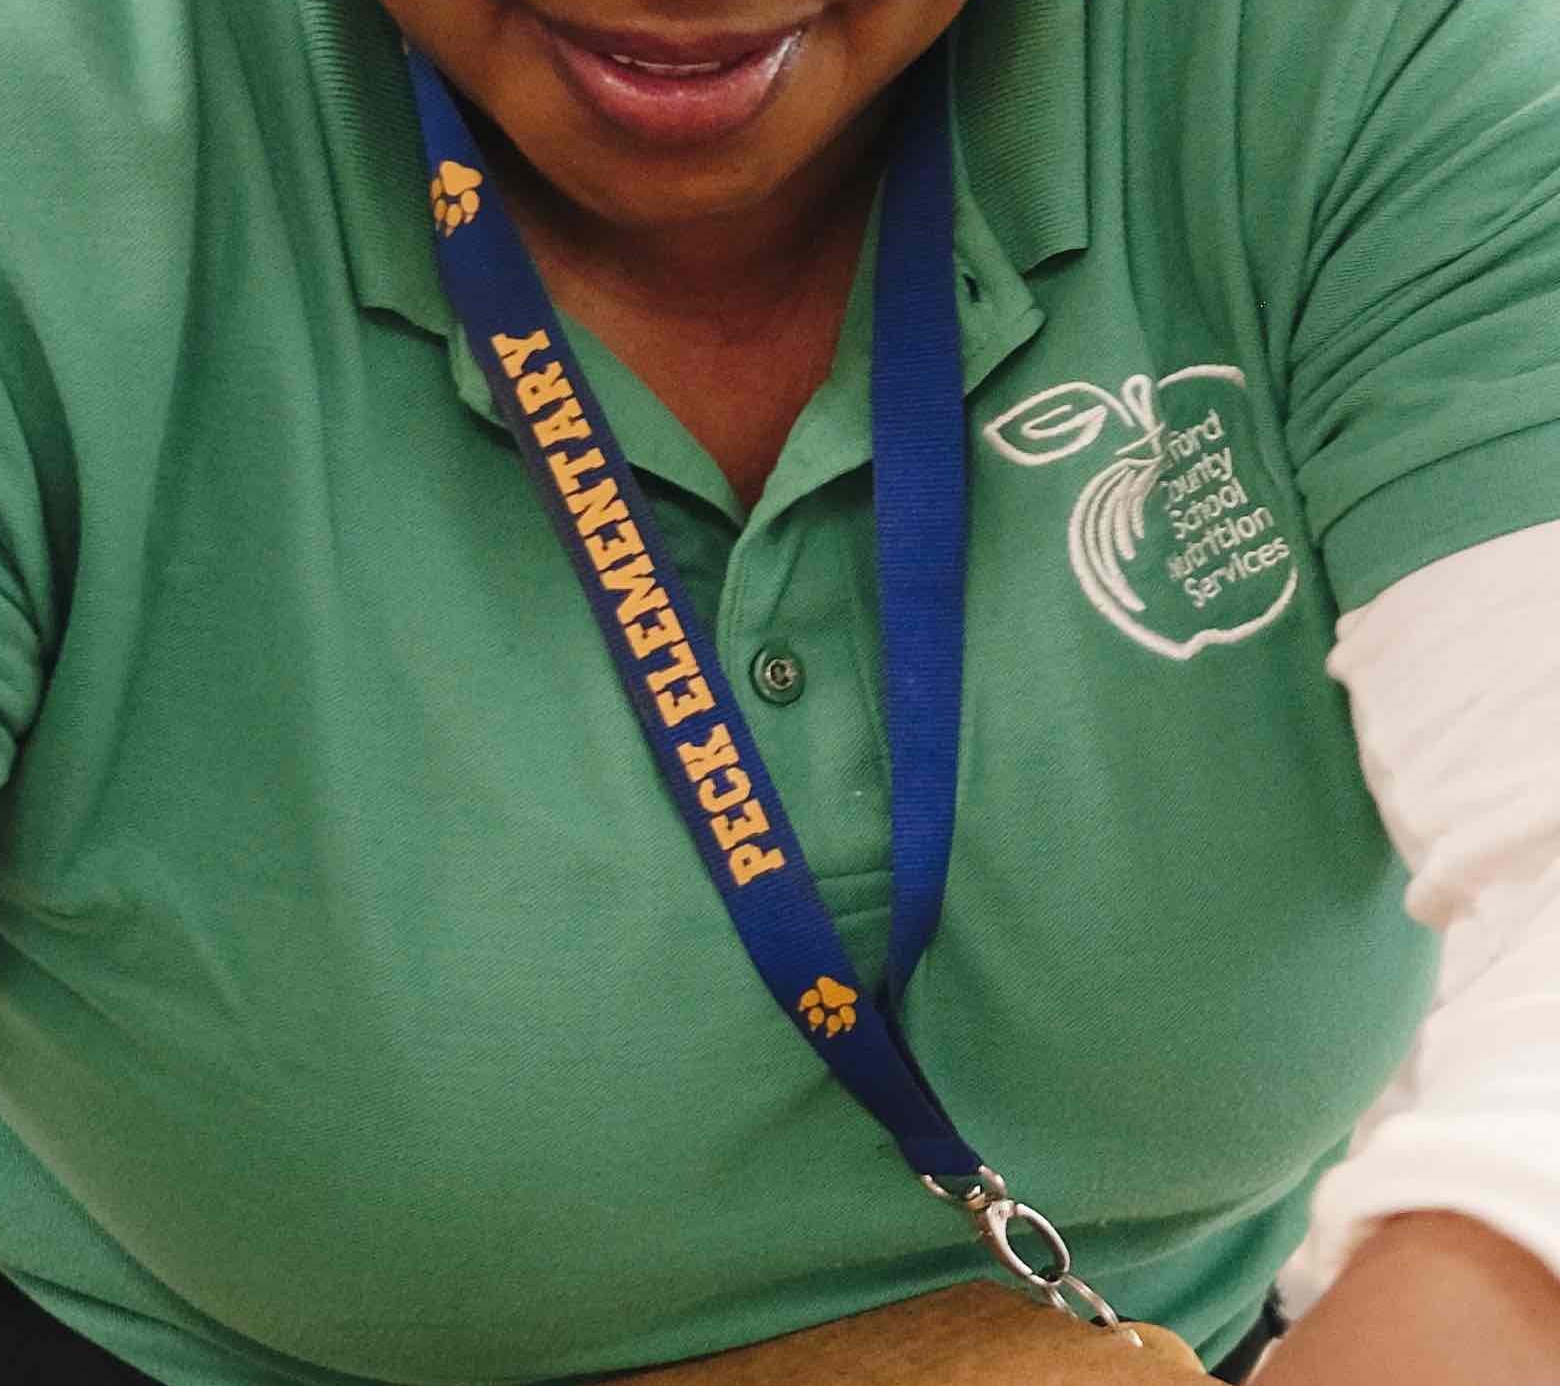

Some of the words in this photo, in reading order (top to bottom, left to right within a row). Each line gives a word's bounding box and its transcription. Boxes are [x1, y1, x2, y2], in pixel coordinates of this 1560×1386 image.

[491, 329, 715, 726] ELEMENTARY
[1184, 537, 1290, 607] Services
[678, 724, 787, 887] PECK
